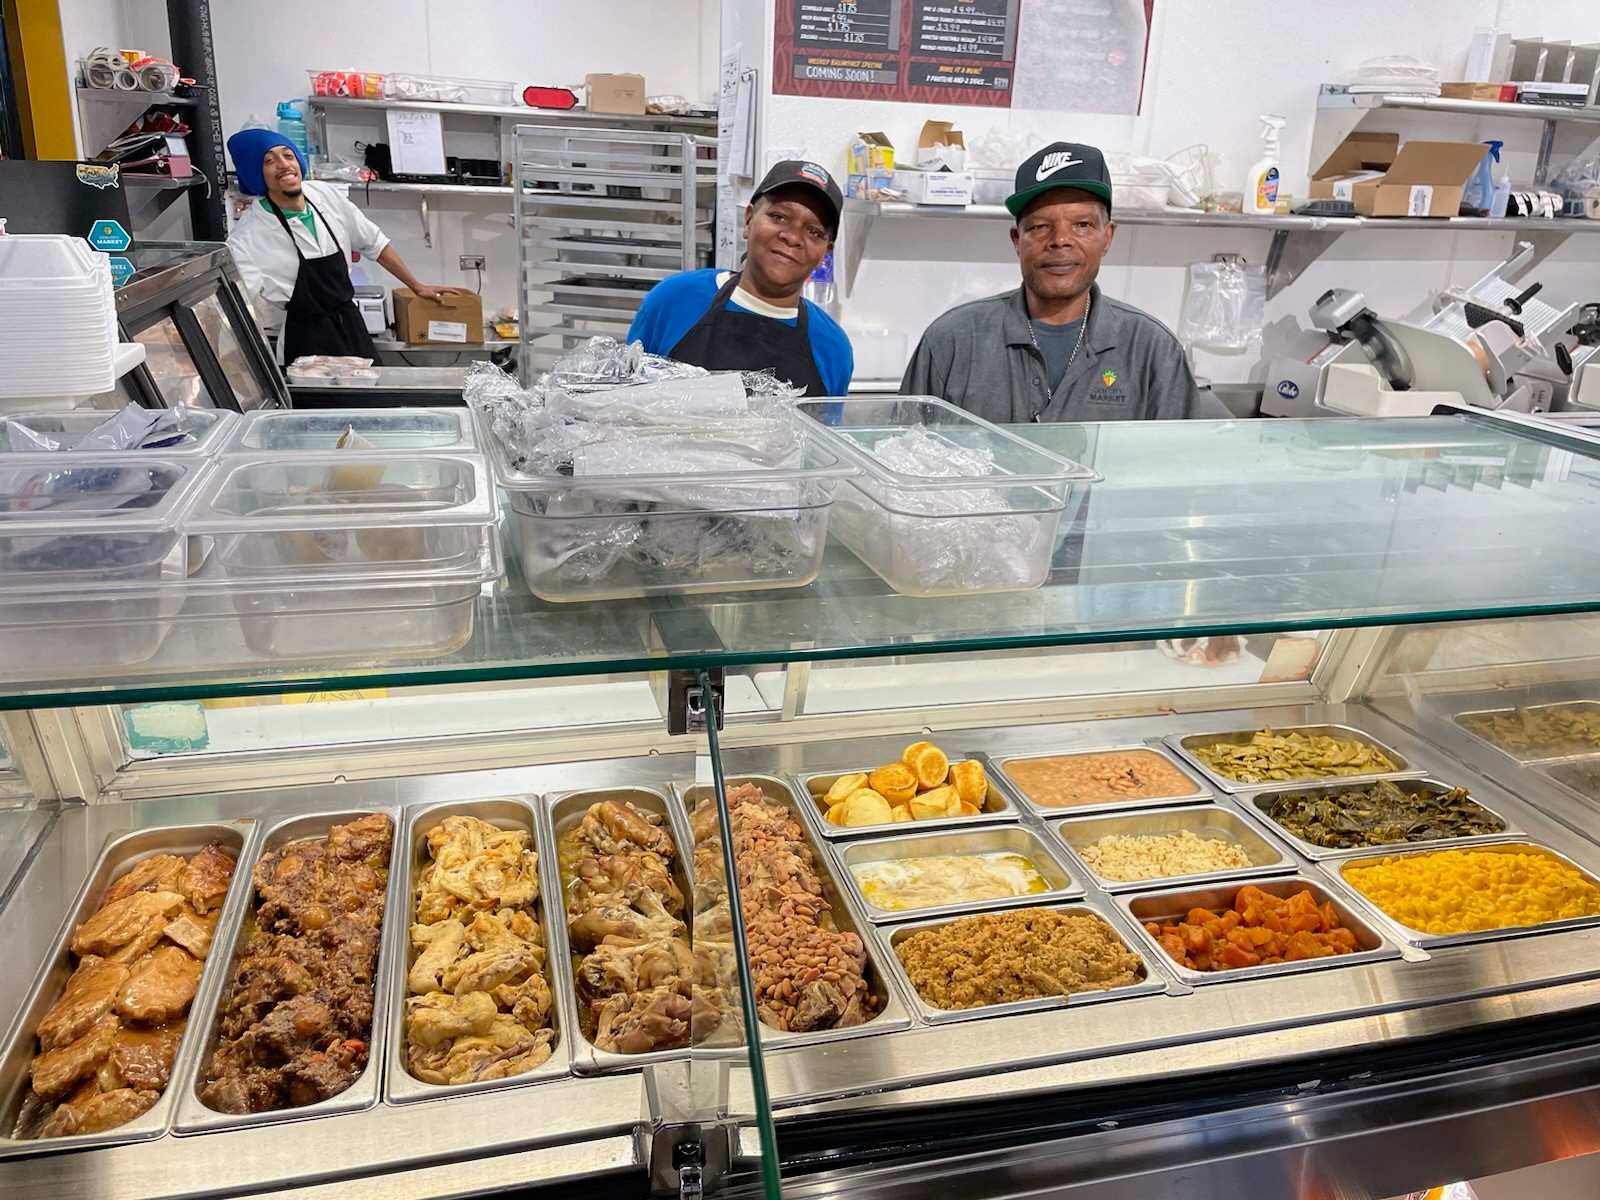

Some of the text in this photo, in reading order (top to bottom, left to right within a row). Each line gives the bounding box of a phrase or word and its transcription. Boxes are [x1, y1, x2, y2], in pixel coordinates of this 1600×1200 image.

[806, 66, 876, 82] COMING SOON!
[1041, 151, 1072, 171] NIKE
[1278, 382, 1298, 398] Globe
